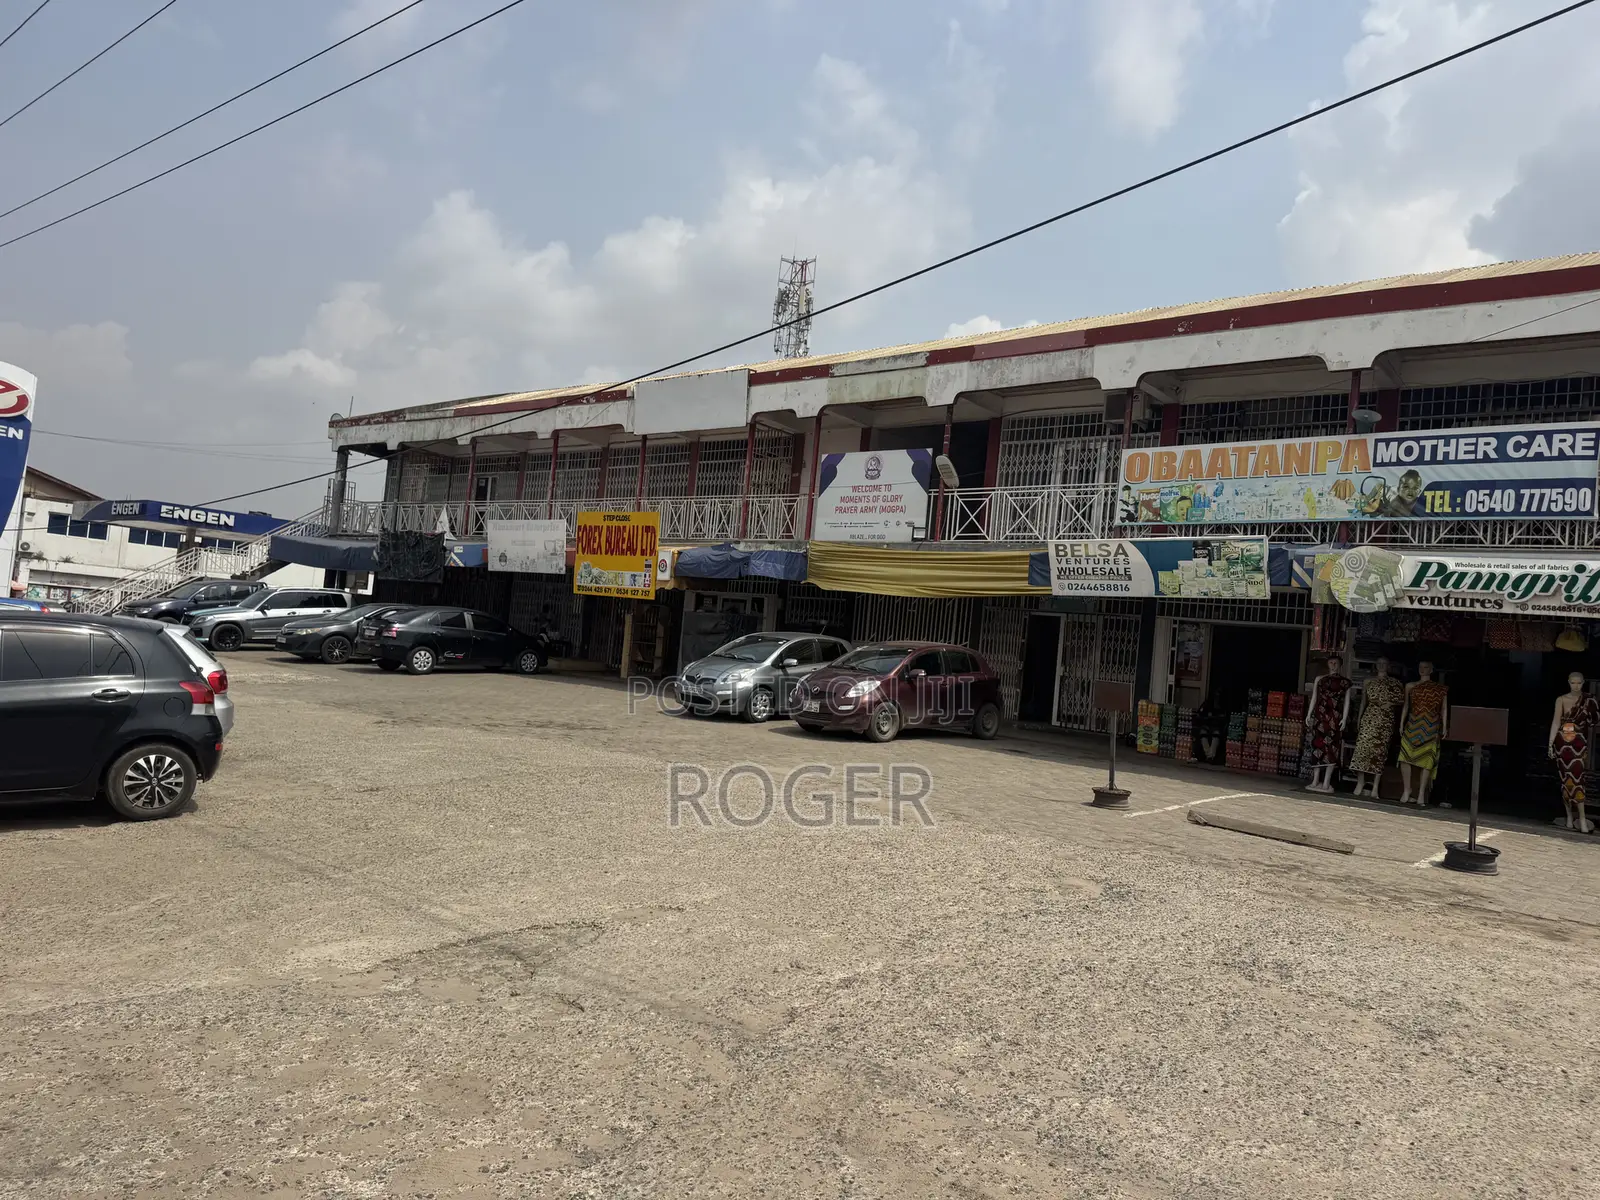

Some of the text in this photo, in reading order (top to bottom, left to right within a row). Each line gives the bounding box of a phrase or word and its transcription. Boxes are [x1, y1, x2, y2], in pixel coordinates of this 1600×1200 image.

[1375, 432, 1597, 463] MOTHER CARE
[1124, 438, 1372, 483] OBAATANPA
[851, 484, 892, 493] WELCOME TO
[839, 494, 903, 504] MOMENTS OF GLORY
[1464, 489, 1516, 513] 0540
[1520, 487, 1592, 513] 777590
[111, 501, 140, 515] ENGEN
[160, 504, 235, 527] ENGEN
[834, 505, 907, 515] PRAYER ARMY (MOGPA)
[577, 524, 604, 555] FOREX
[604, 525, 639, 556] BUREAU
[1054, 543, 1129, 558] BELSA
[1057, 566, 1132, 576] WHOLESALE
[1067, 582, 1131, 592] 0244658816
[1407, 594, 1504, 609] ventures
